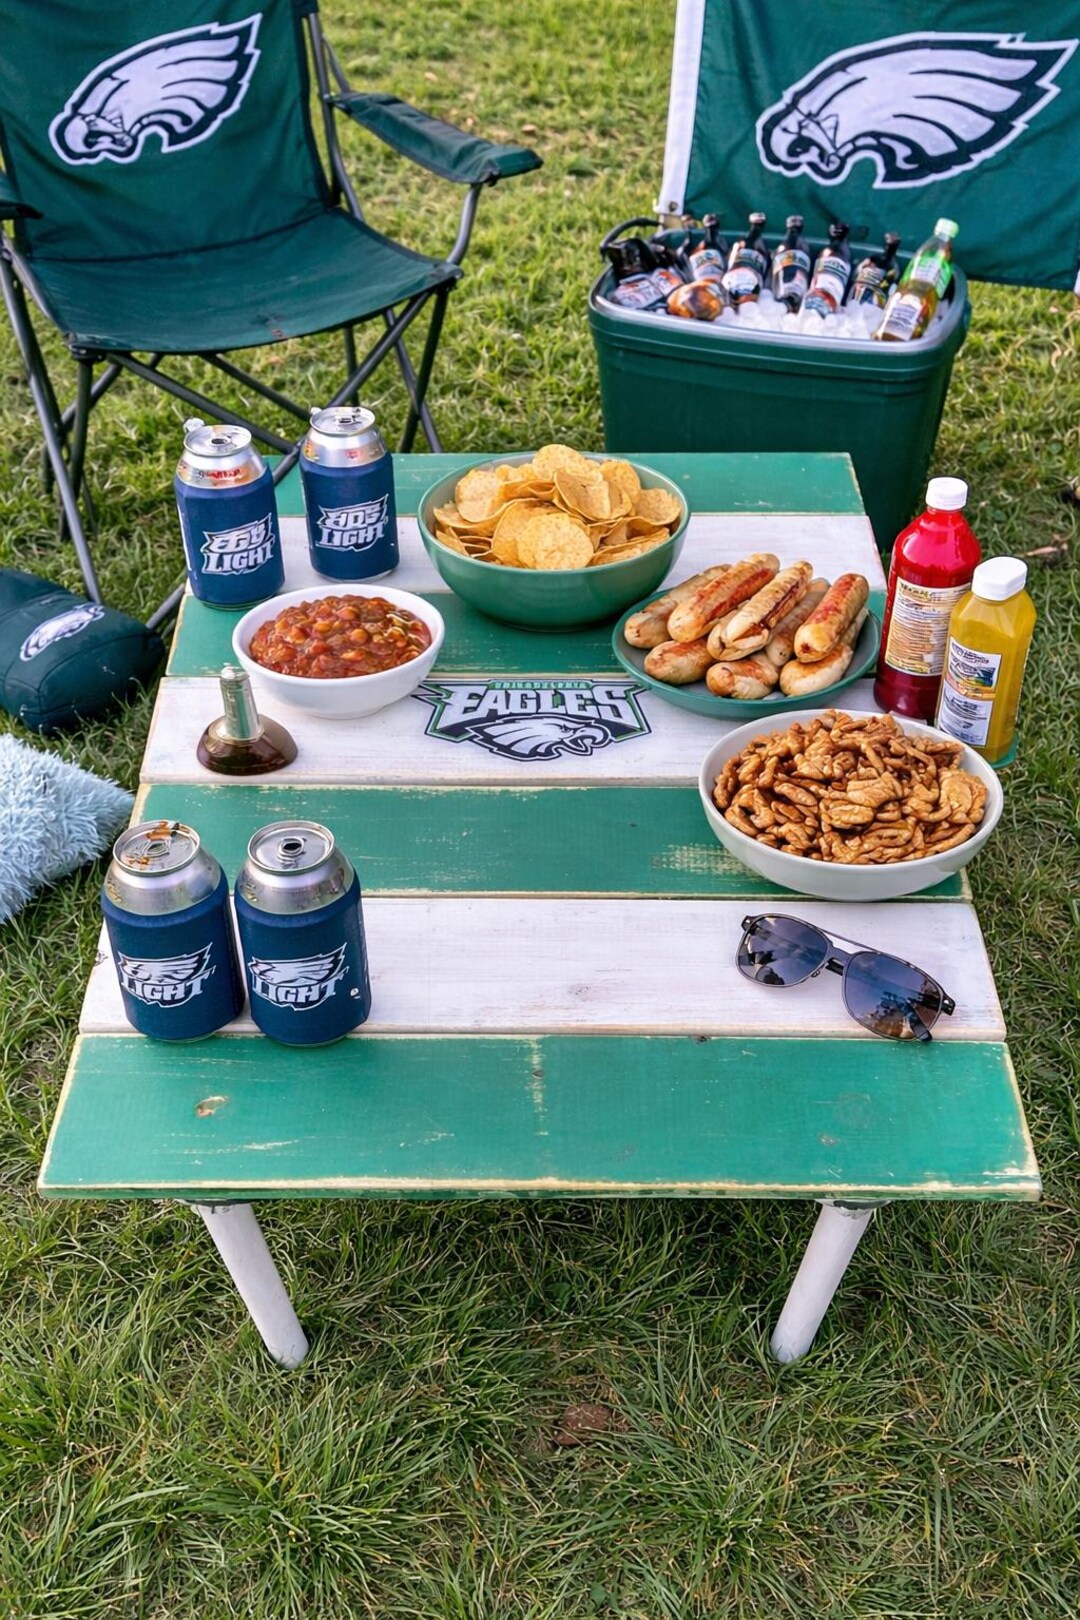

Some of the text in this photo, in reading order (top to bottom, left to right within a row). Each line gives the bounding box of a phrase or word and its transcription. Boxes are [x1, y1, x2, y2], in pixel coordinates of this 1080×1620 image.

[319, 522, 385, 547] LIGHT
[206, 540, 274, 572] LIGHT
[436, 685, 641, 729] EAGLES
[121, 971, 211, 1001] LIGHT
[253, 973, 345, 1003] LIGHT
